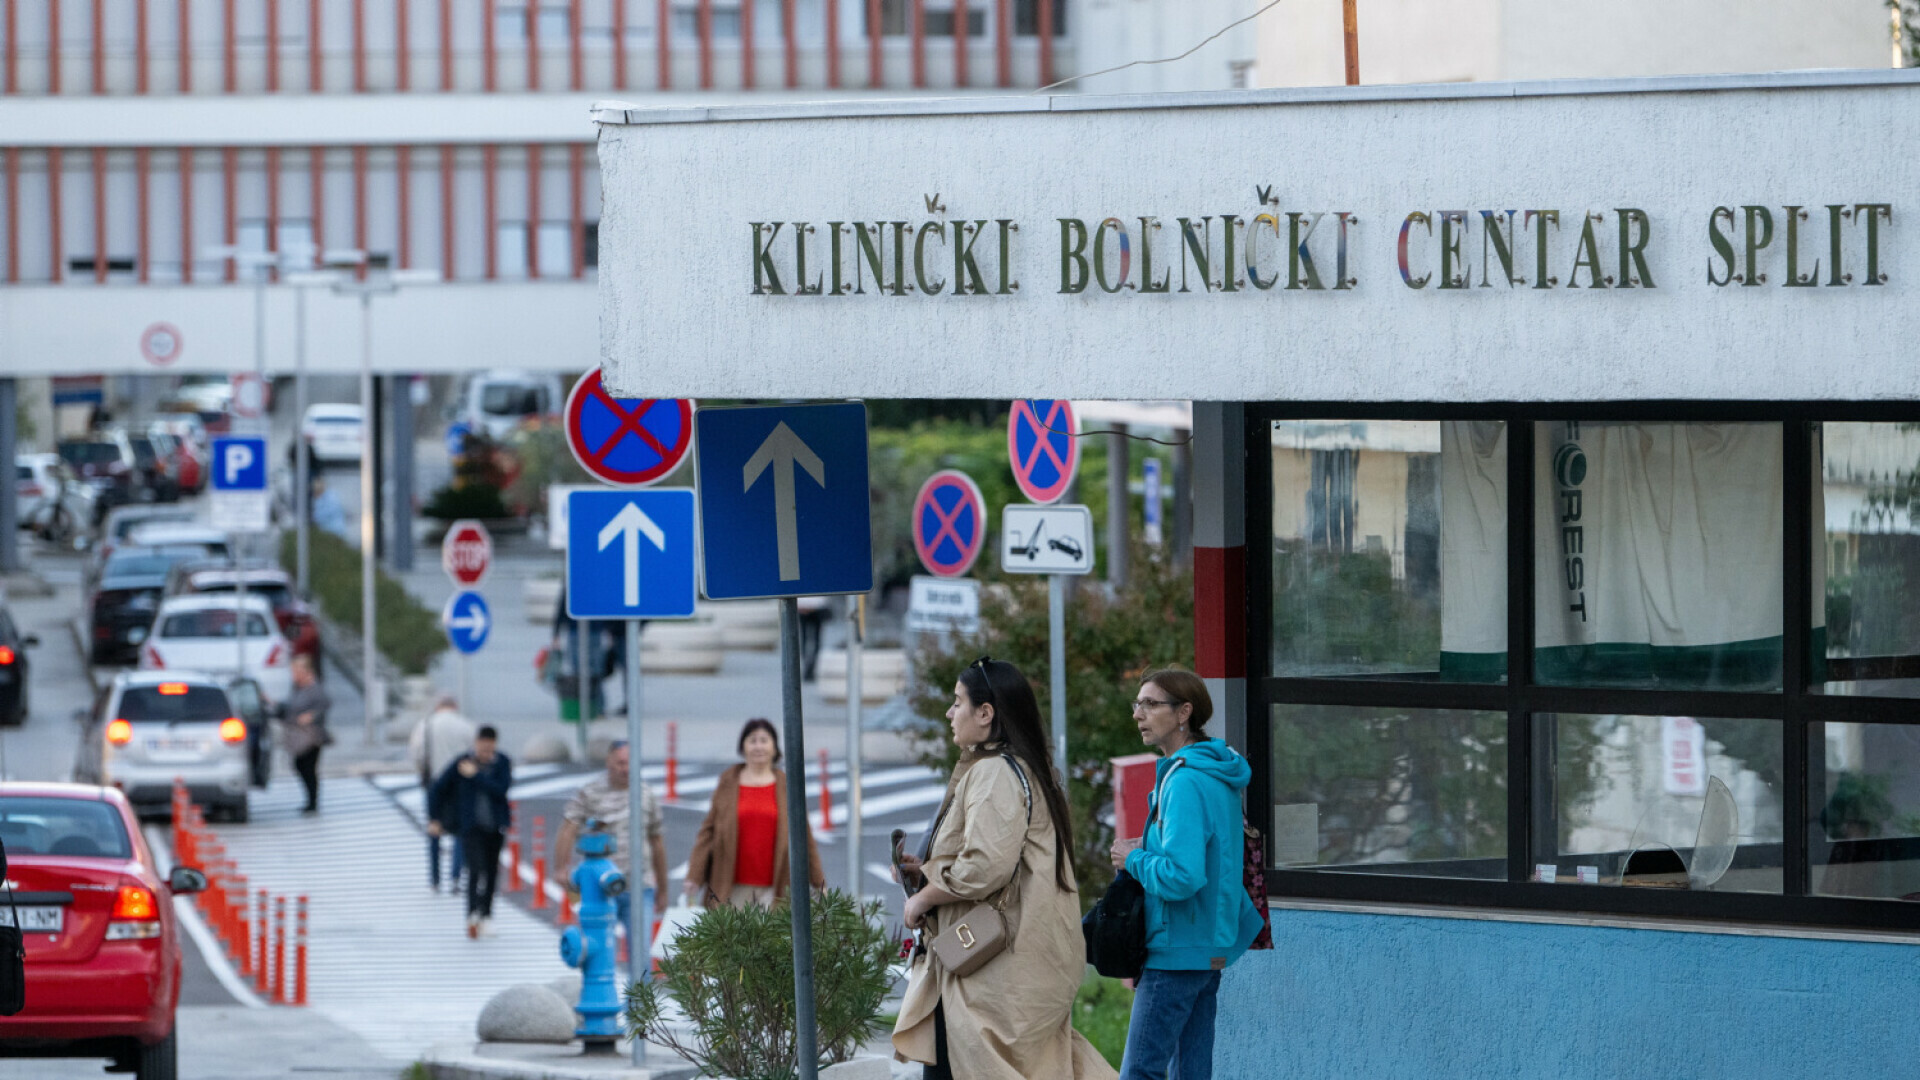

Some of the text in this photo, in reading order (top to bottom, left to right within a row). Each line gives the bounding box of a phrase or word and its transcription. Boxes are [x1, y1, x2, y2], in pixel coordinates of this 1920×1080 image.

[748, 184, 1892, 296] KLINIČKI BOLNIČKI CENTAR SPLIT
[225, 443, 254, 485] P
[447, 541, 489, 569] STOP
